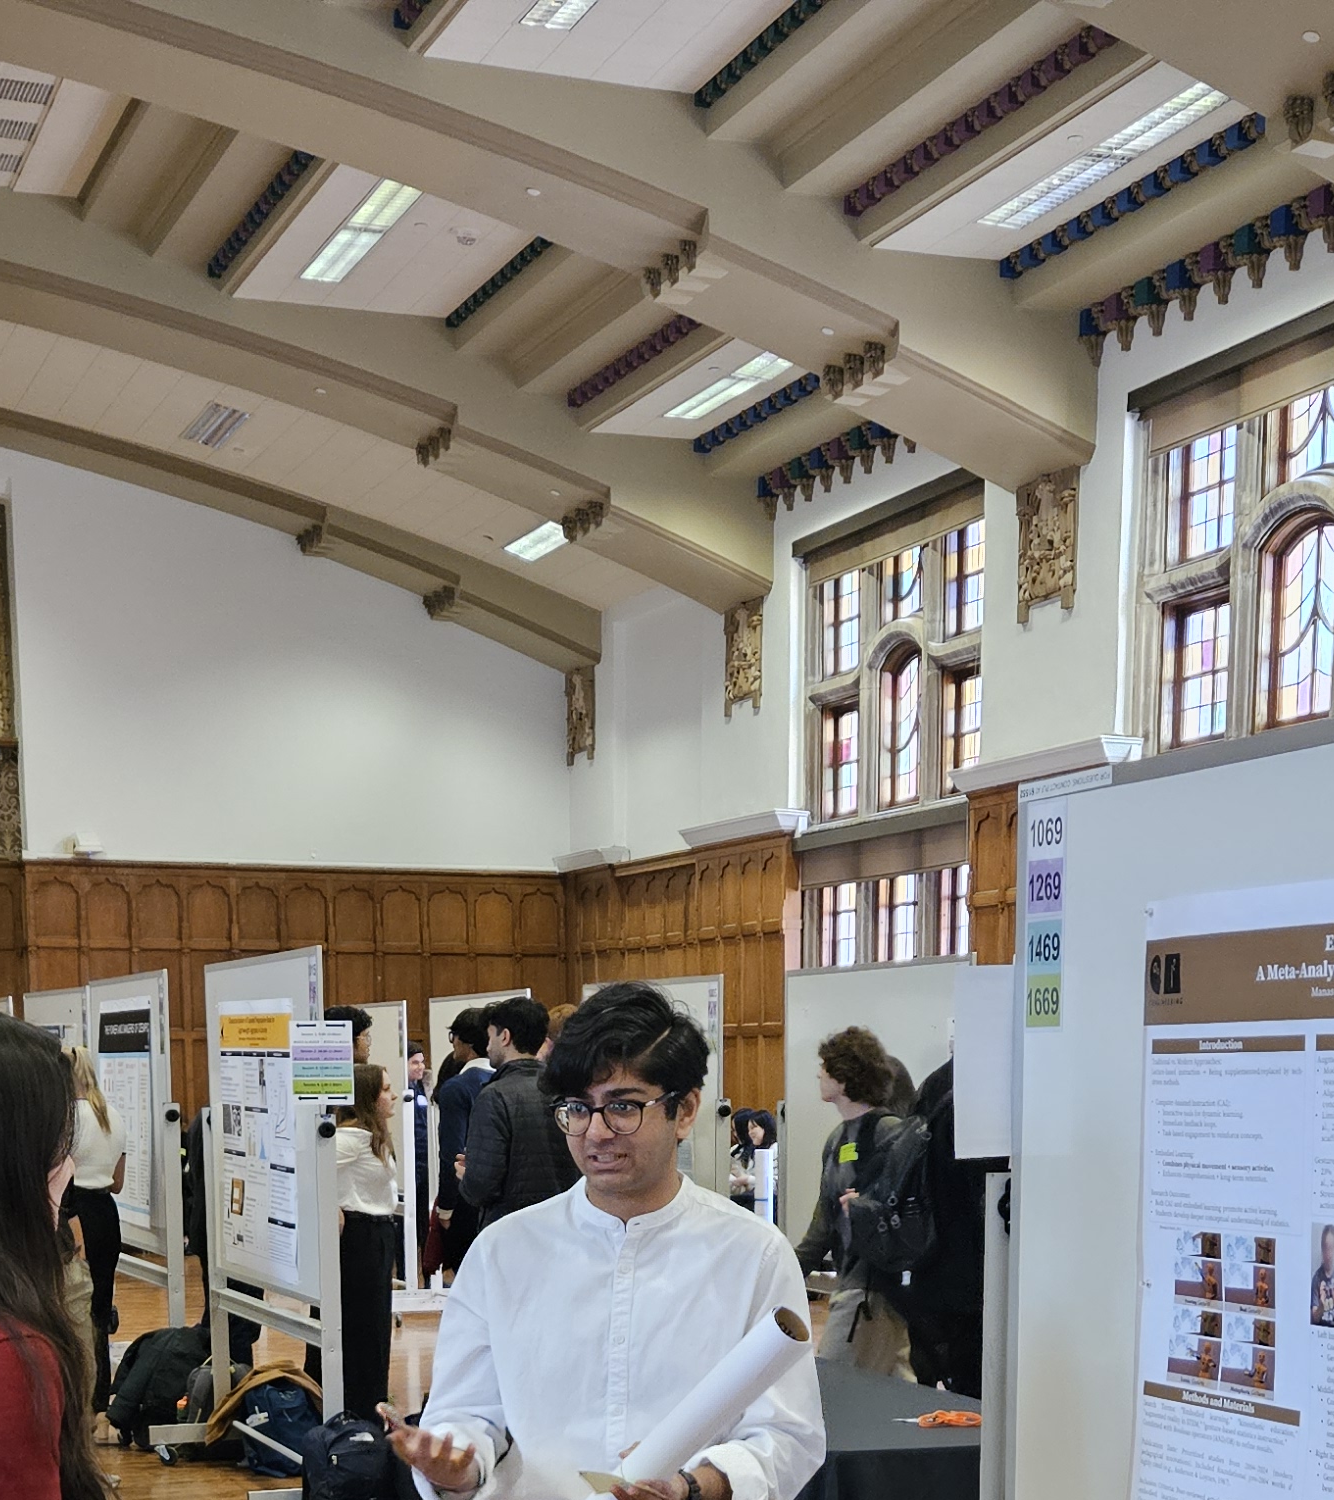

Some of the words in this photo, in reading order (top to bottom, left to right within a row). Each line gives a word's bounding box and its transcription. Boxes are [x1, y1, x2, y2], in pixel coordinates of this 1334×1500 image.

[1030, 816, 1063, 848] 1069
[1028, 871, 1062, 903] 1269
[1028, 932, 1061, 964] 1469
[1256, 965, 1265, 981] A
[1027, 986, 1060, 1017] 1669
[1311, 986, 1334, 997] Manas
[1199, 1039, 1243, 1051] Introduction
[1182, 1391, 1208, 1404] Methods
[1210, 1398, 1222, 1407] and
[1223, 1399, 1255, 1413] Materials
